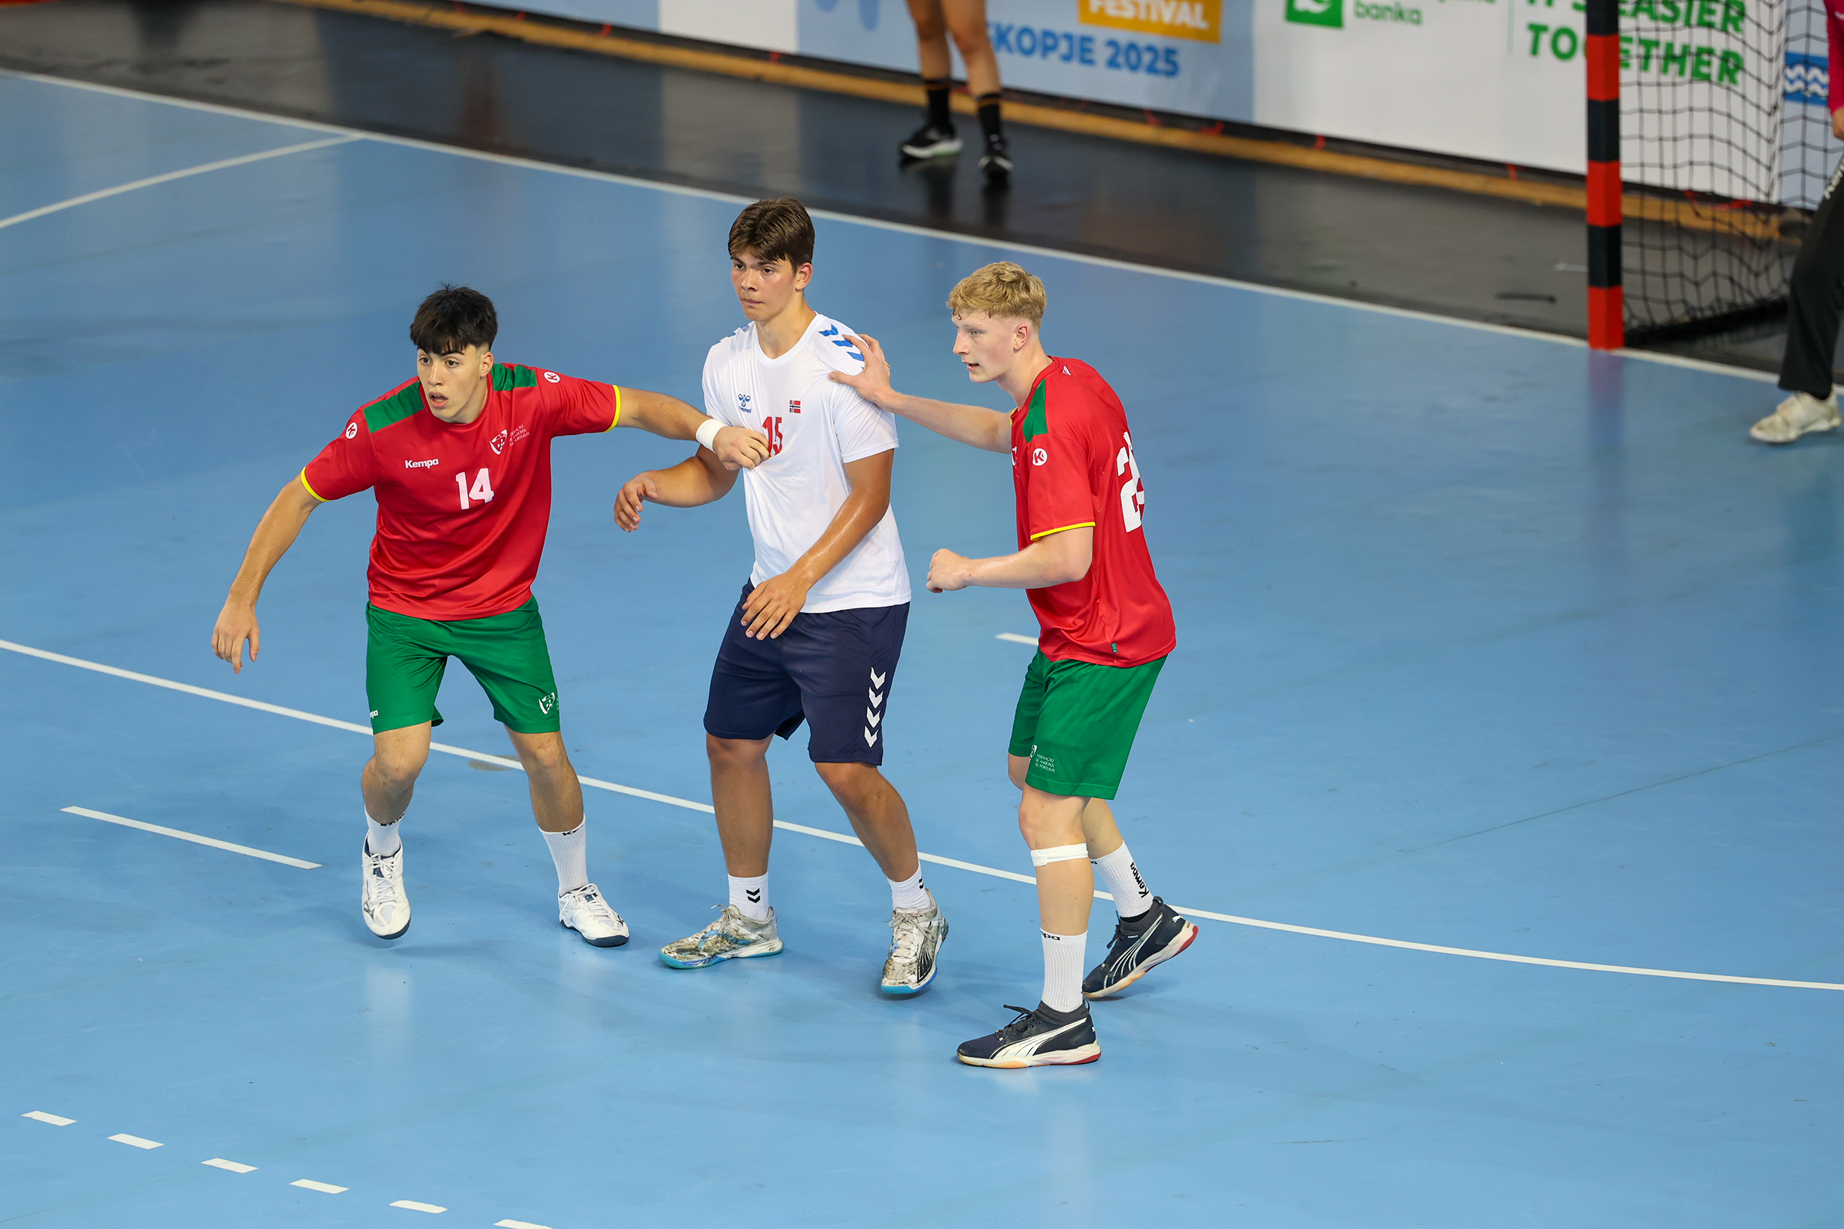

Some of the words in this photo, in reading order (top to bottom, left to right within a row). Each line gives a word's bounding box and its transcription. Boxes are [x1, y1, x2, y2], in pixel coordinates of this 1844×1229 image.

[1619, 0, 1746, 33] ASIER
[988, 22, 1096, 66] KOPJE
[1104, 38, 1181, 78] 2025
[1528, 23, 1744, 85] TOETHER
[404, 458, 440, 469] Kempa
[455, 468, 495, 510] 14
[1129, 861, 1150, 899] Kempa
